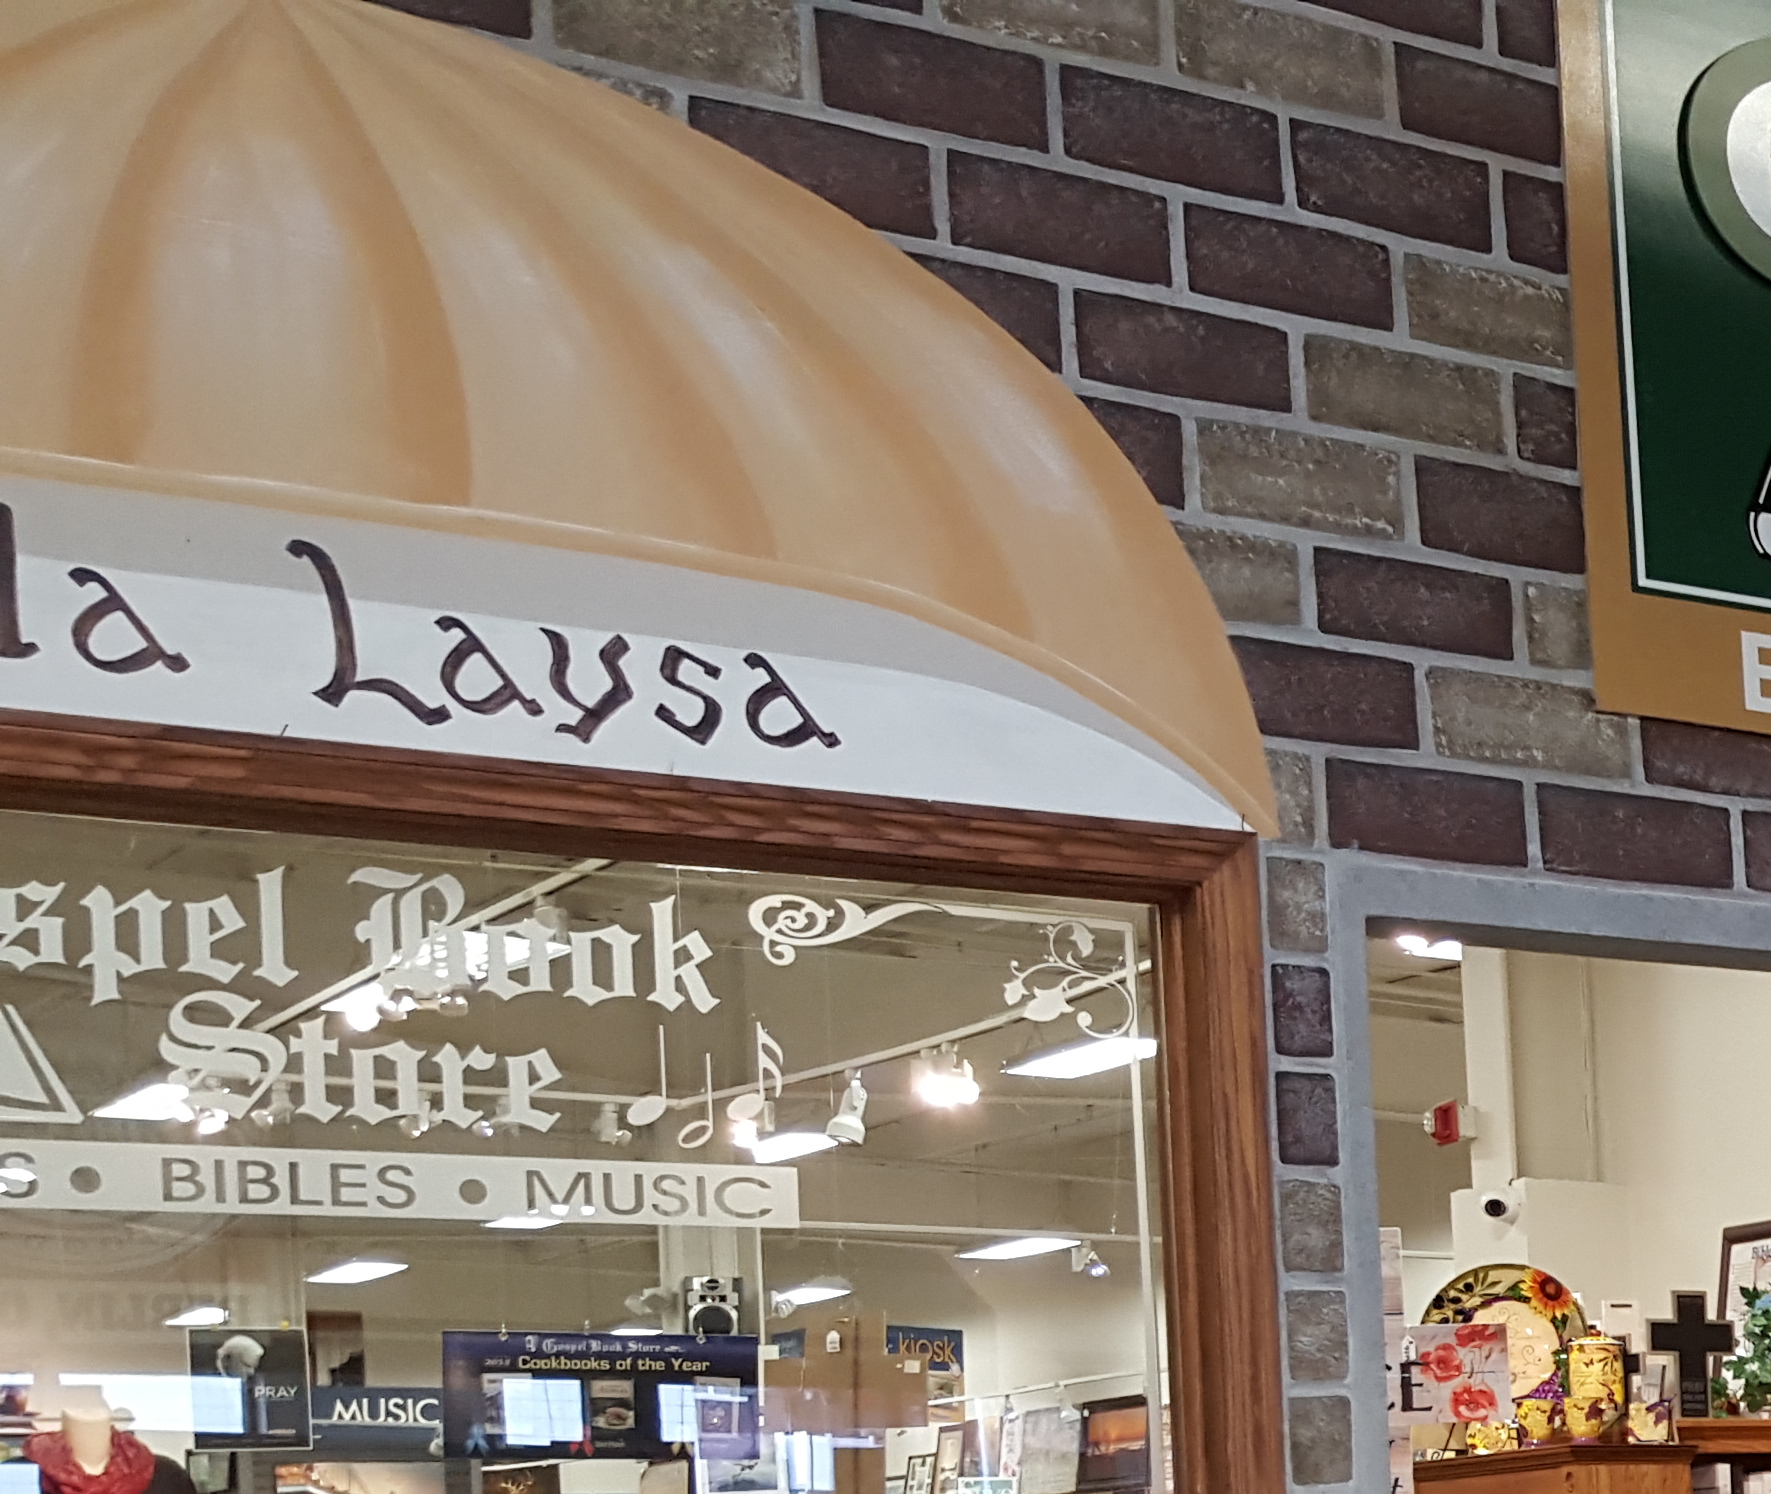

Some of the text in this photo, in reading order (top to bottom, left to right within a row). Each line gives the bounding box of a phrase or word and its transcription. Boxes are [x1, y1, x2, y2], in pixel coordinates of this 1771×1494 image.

[285, 537, 843, 752] Laysa
[351, 866, 721, 1015] Book
[157, 989, 568, 1137] Store
[159, 1156, 776, 1223] BIBLES MUSIC
[517, 1355, 711, 1373] Cookbooks of the Year
[898, 1337, 958, 1366] kiosk
[254, 1384, 299, 1399] PRAY
[331, 1397, 441, 1426] MUSIC
